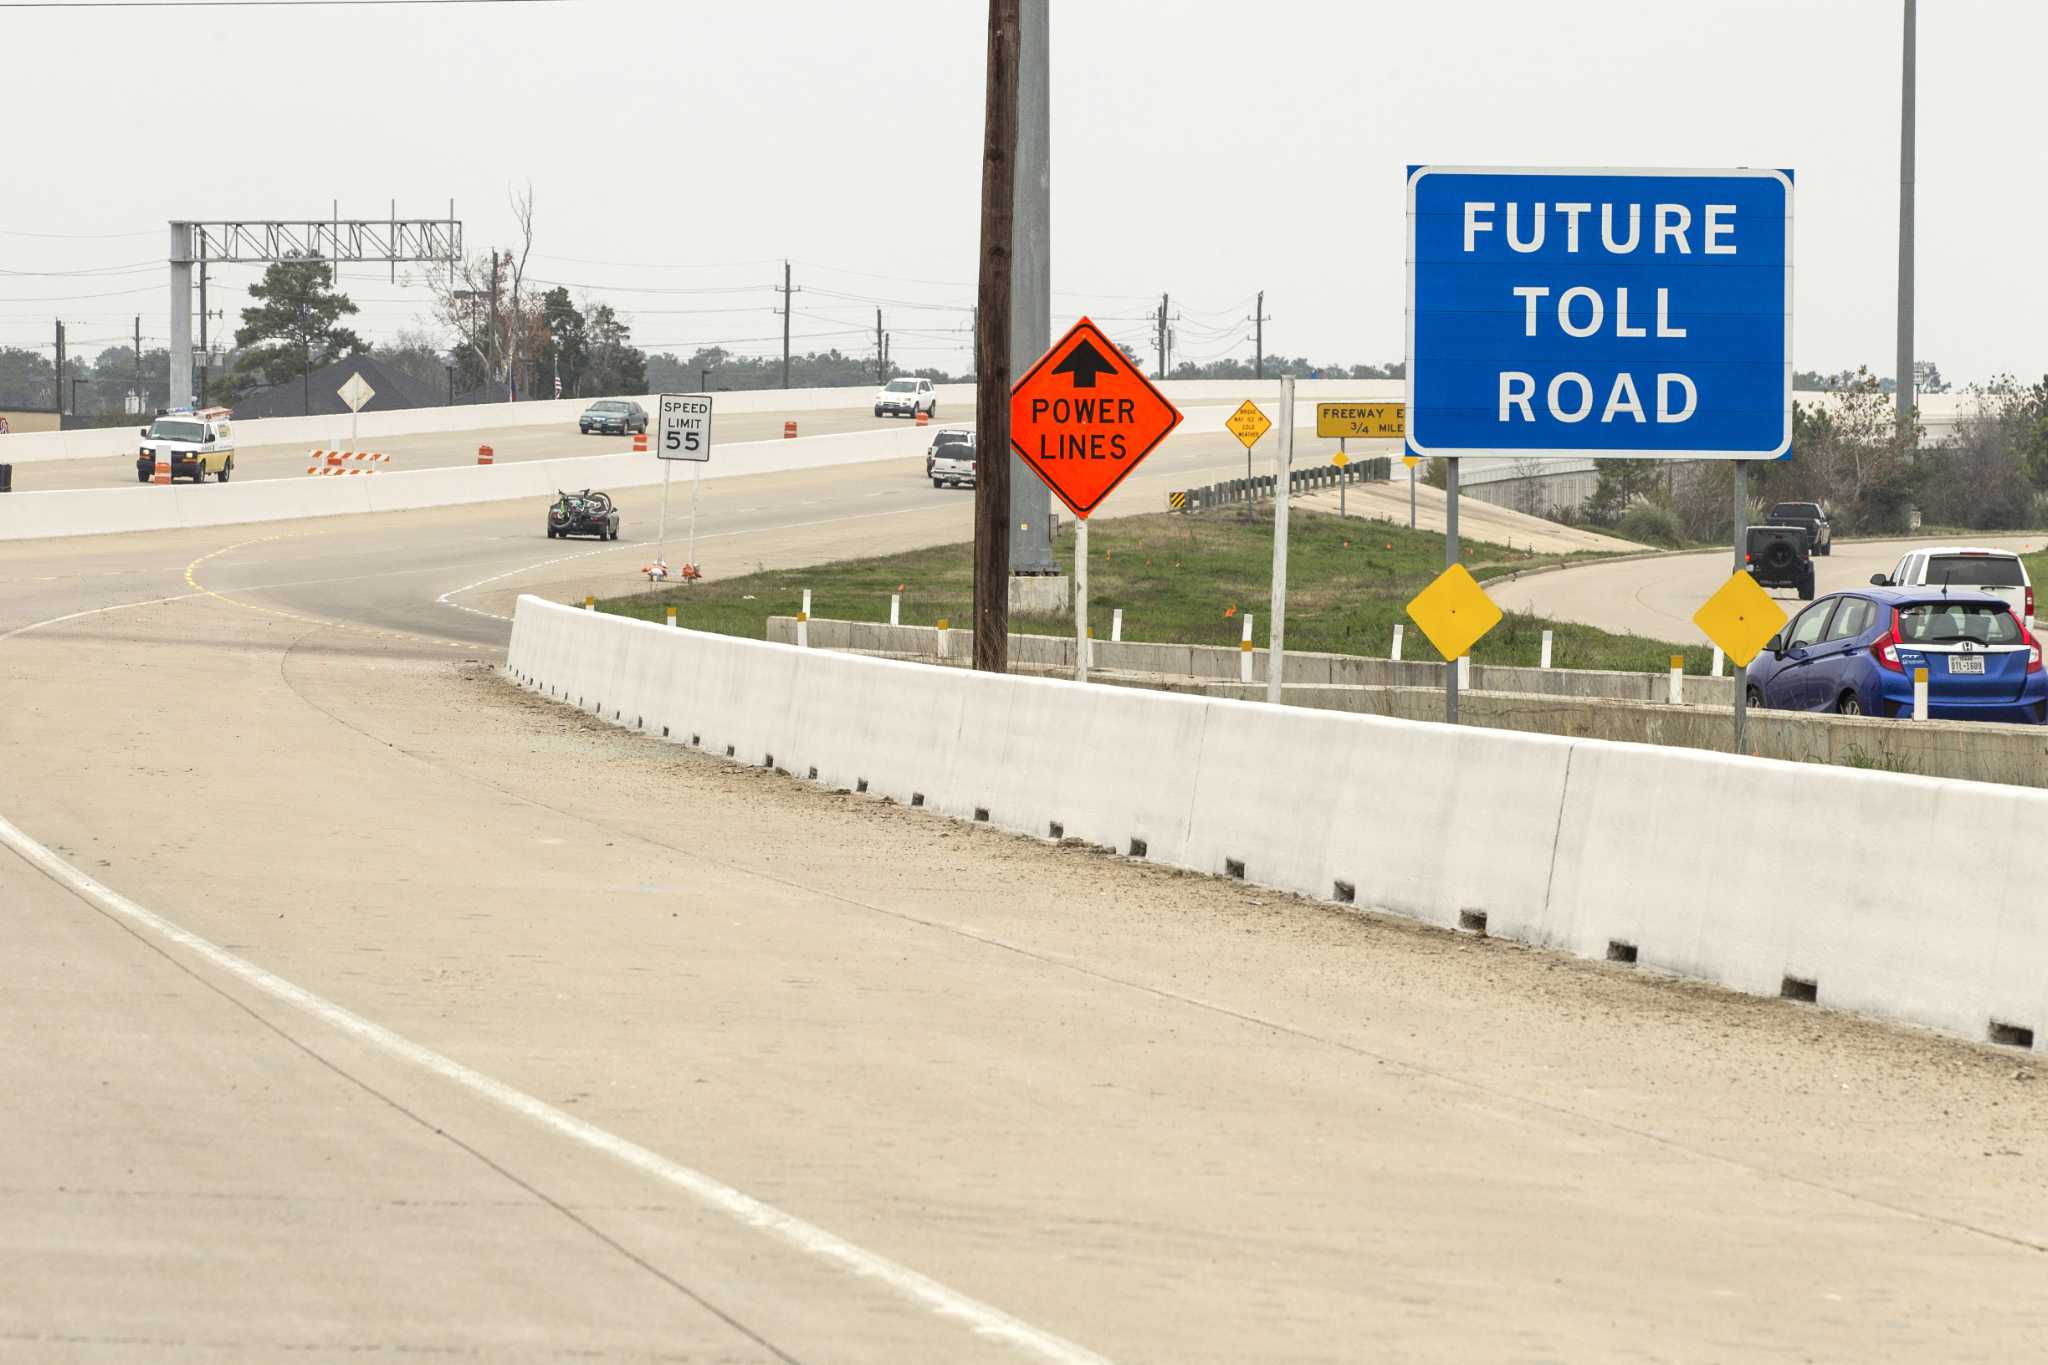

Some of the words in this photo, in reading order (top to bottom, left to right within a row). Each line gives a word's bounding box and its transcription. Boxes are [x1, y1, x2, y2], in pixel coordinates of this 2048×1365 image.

[1462, 201, 1738, 255] FUTURE
[1512, 285, 1687, 339] TOLL
[664, 401, 708, 414] SPEED
[1498, 370, 1698, 424] ROAD
[1032, 398, 1135, 424] POWER
[1323, 408, 1384, 419] FREEWAY
[668, 417, 702, 429] LIMIT
[1350, 422, 1369, 434] 3/4
[1379, 423, 1404, 433] MILE
[666, 430, 700, 451] 55
[1040, 433, 1127, 460] LINES
